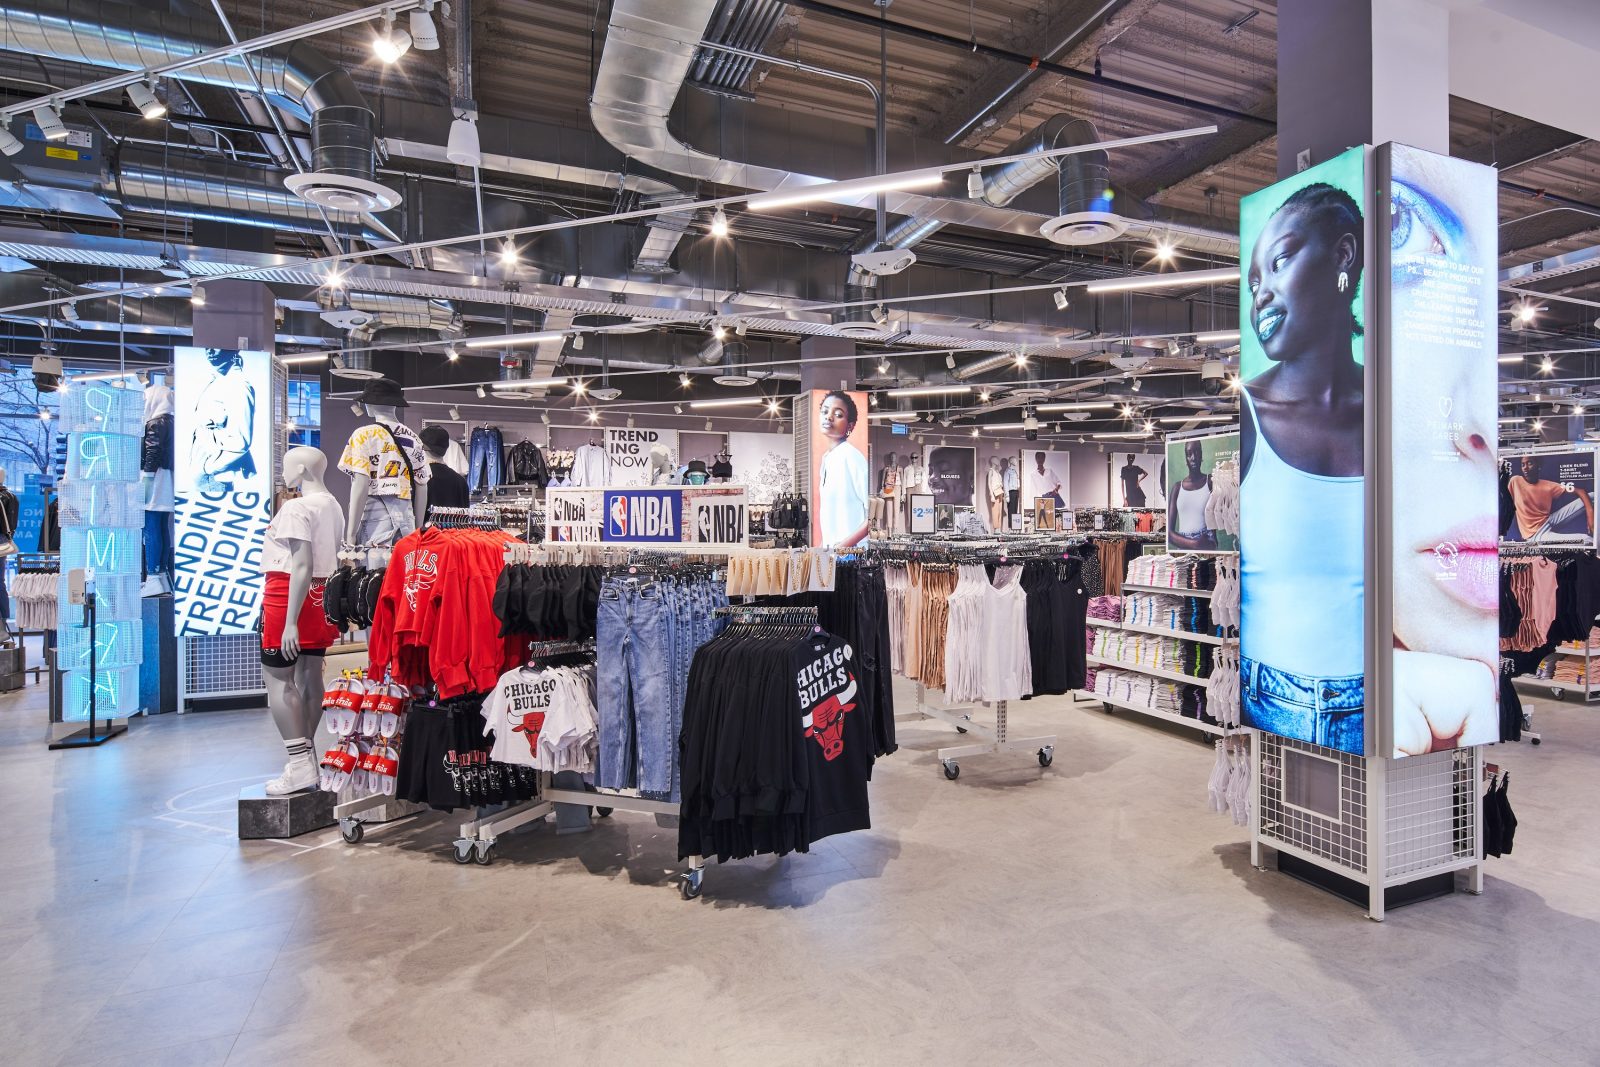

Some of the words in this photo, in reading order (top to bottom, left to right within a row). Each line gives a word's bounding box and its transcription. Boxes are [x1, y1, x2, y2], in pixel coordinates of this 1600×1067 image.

[1424, 268, 1448, 279] BEAUTY
[1449, 274, 1481, 286] PRODUCTS
[1457, 296, 1478, 305] UNDER
[1455, 307, 1476, 316] BUNNY
[1456, 317, 1467, 325] THE
[1468, 319, 1485, 328] GOLD
[1452, 327, 1485, 339] PRODUCTS
[609, 430, 659, 442] TREND
[610, 443, 640, 455] ING
[610, 456, 649, 468] NOW
[563, 497, 586, 522] NBA
[630, 496, 675, 537] NBA
[913, 508, 934, 518] $2.50
[713, 504, 744, 544] NBA
[174, 491, 229, 629] ENDIN
[180, 491, 260, 637] TRENDING
[215, 497, 272, 636] RENDIN
[797, 644, 853, 689] HICAGO
[504, 678, 557, 699] CHICAGO
[798, 667, 848, 710] BULLS
[514, 694, 551, 711] BULLS
